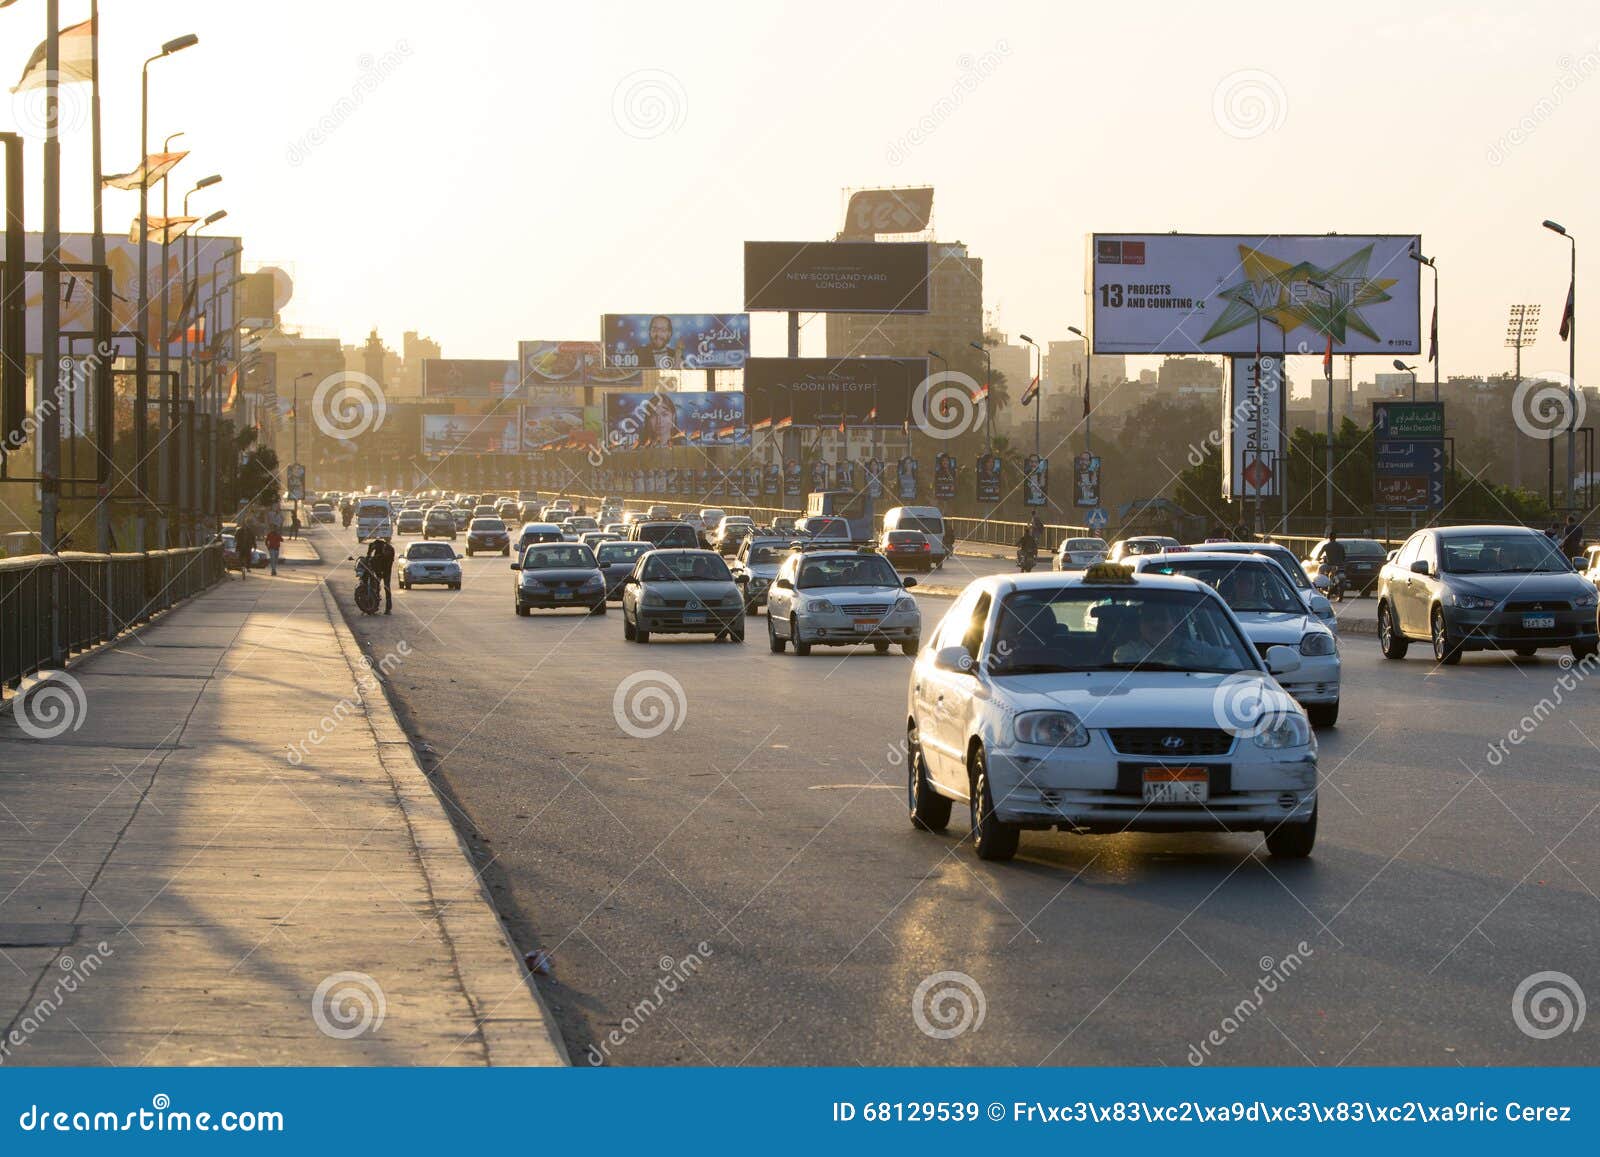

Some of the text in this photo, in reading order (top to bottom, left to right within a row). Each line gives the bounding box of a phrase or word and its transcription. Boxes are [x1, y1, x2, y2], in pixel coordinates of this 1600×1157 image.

[786, 272, 887, 280] NEW SCOTLAND YARD
[1100, 284, 1171, 307] 13 PROJECTS
[1127, 298, 1192, 308] AND COUNTING
[792, 383, 824, 392] SOON
[828, 383, 839, 391] IN
